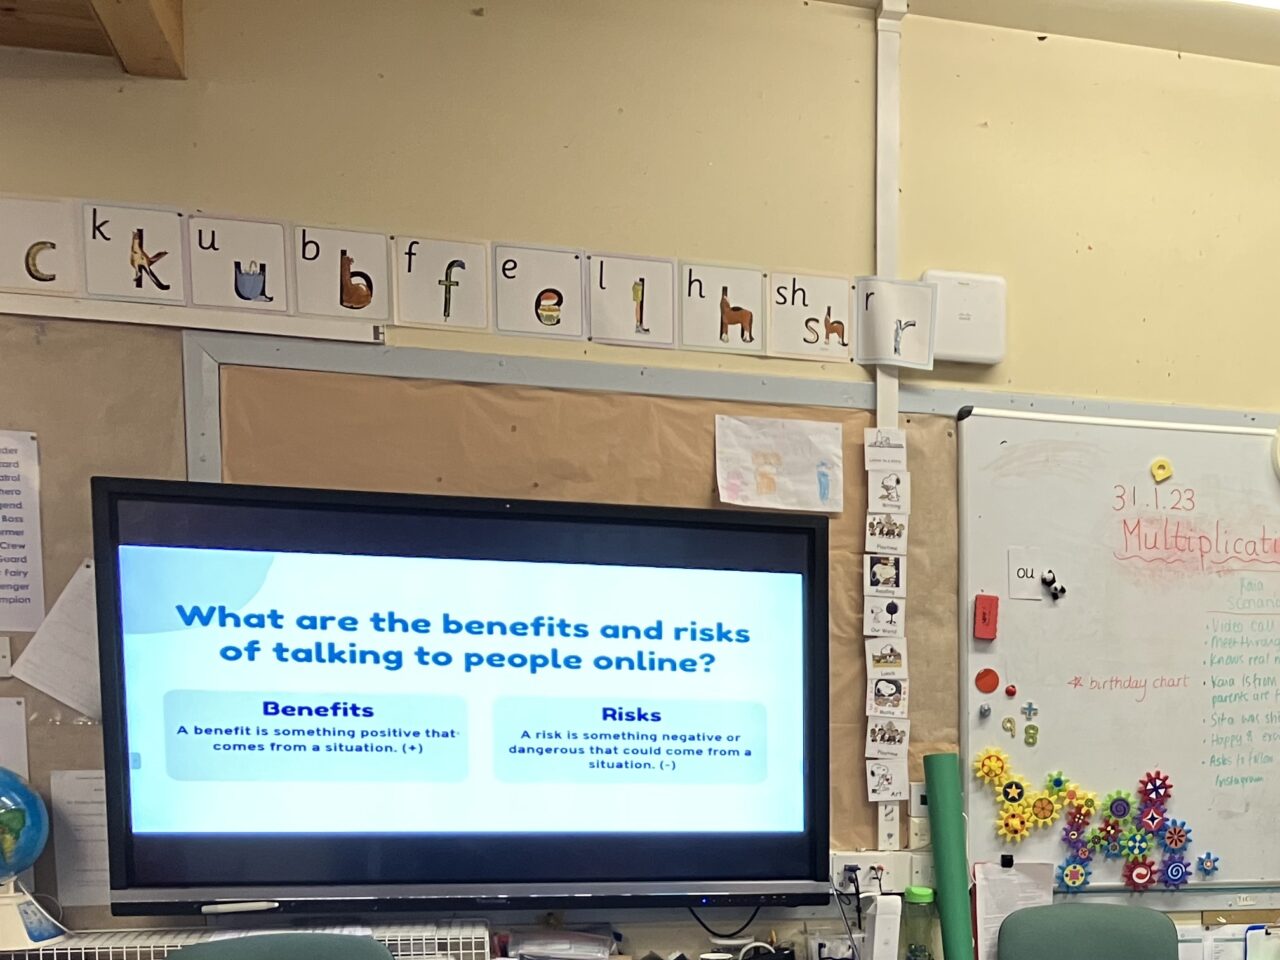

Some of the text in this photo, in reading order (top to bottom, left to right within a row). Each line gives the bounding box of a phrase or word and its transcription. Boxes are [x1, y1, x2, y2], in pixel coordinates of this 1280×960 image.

[92, 208, 111, 241] k
[198, 229, 219, 252] u
[302, 230, 320, 261] b
[130, 228, 171, 290] k
[404, 241, 420, 273] f
[500, 257, 518, 280] e
[339, 249, 373, 310] b
[438, 259, 466, 321] f
[687, 268, 706, 300] h
[534, 287, 564, 327] e
[775, 280, 809, 308] sh
[864, 288, 876, 312] r
[719, 285, 755, 344] h
[802, 305, 849, 347] sh
[1016, 567, 1035, 580] ou
[176, 604, 751, 643] What are the benefits and risks
[219, 640, 716, 674] of talking to people online?
[1089, 674, 1190, 700] birthday chart
[262, 701, 375, 718] Benefits
[602, 706, 662, 723] Risks
[176, 725, 457, 740] A benefit is something positive that
[520, 729, 741, 744] A risk is something negative or
[213, 741, 424, 755] comes from a situation. (+)
[508, 743, 752, 757] dangerous that could come from a
[588, 758, 676, 772] situation. (-)
